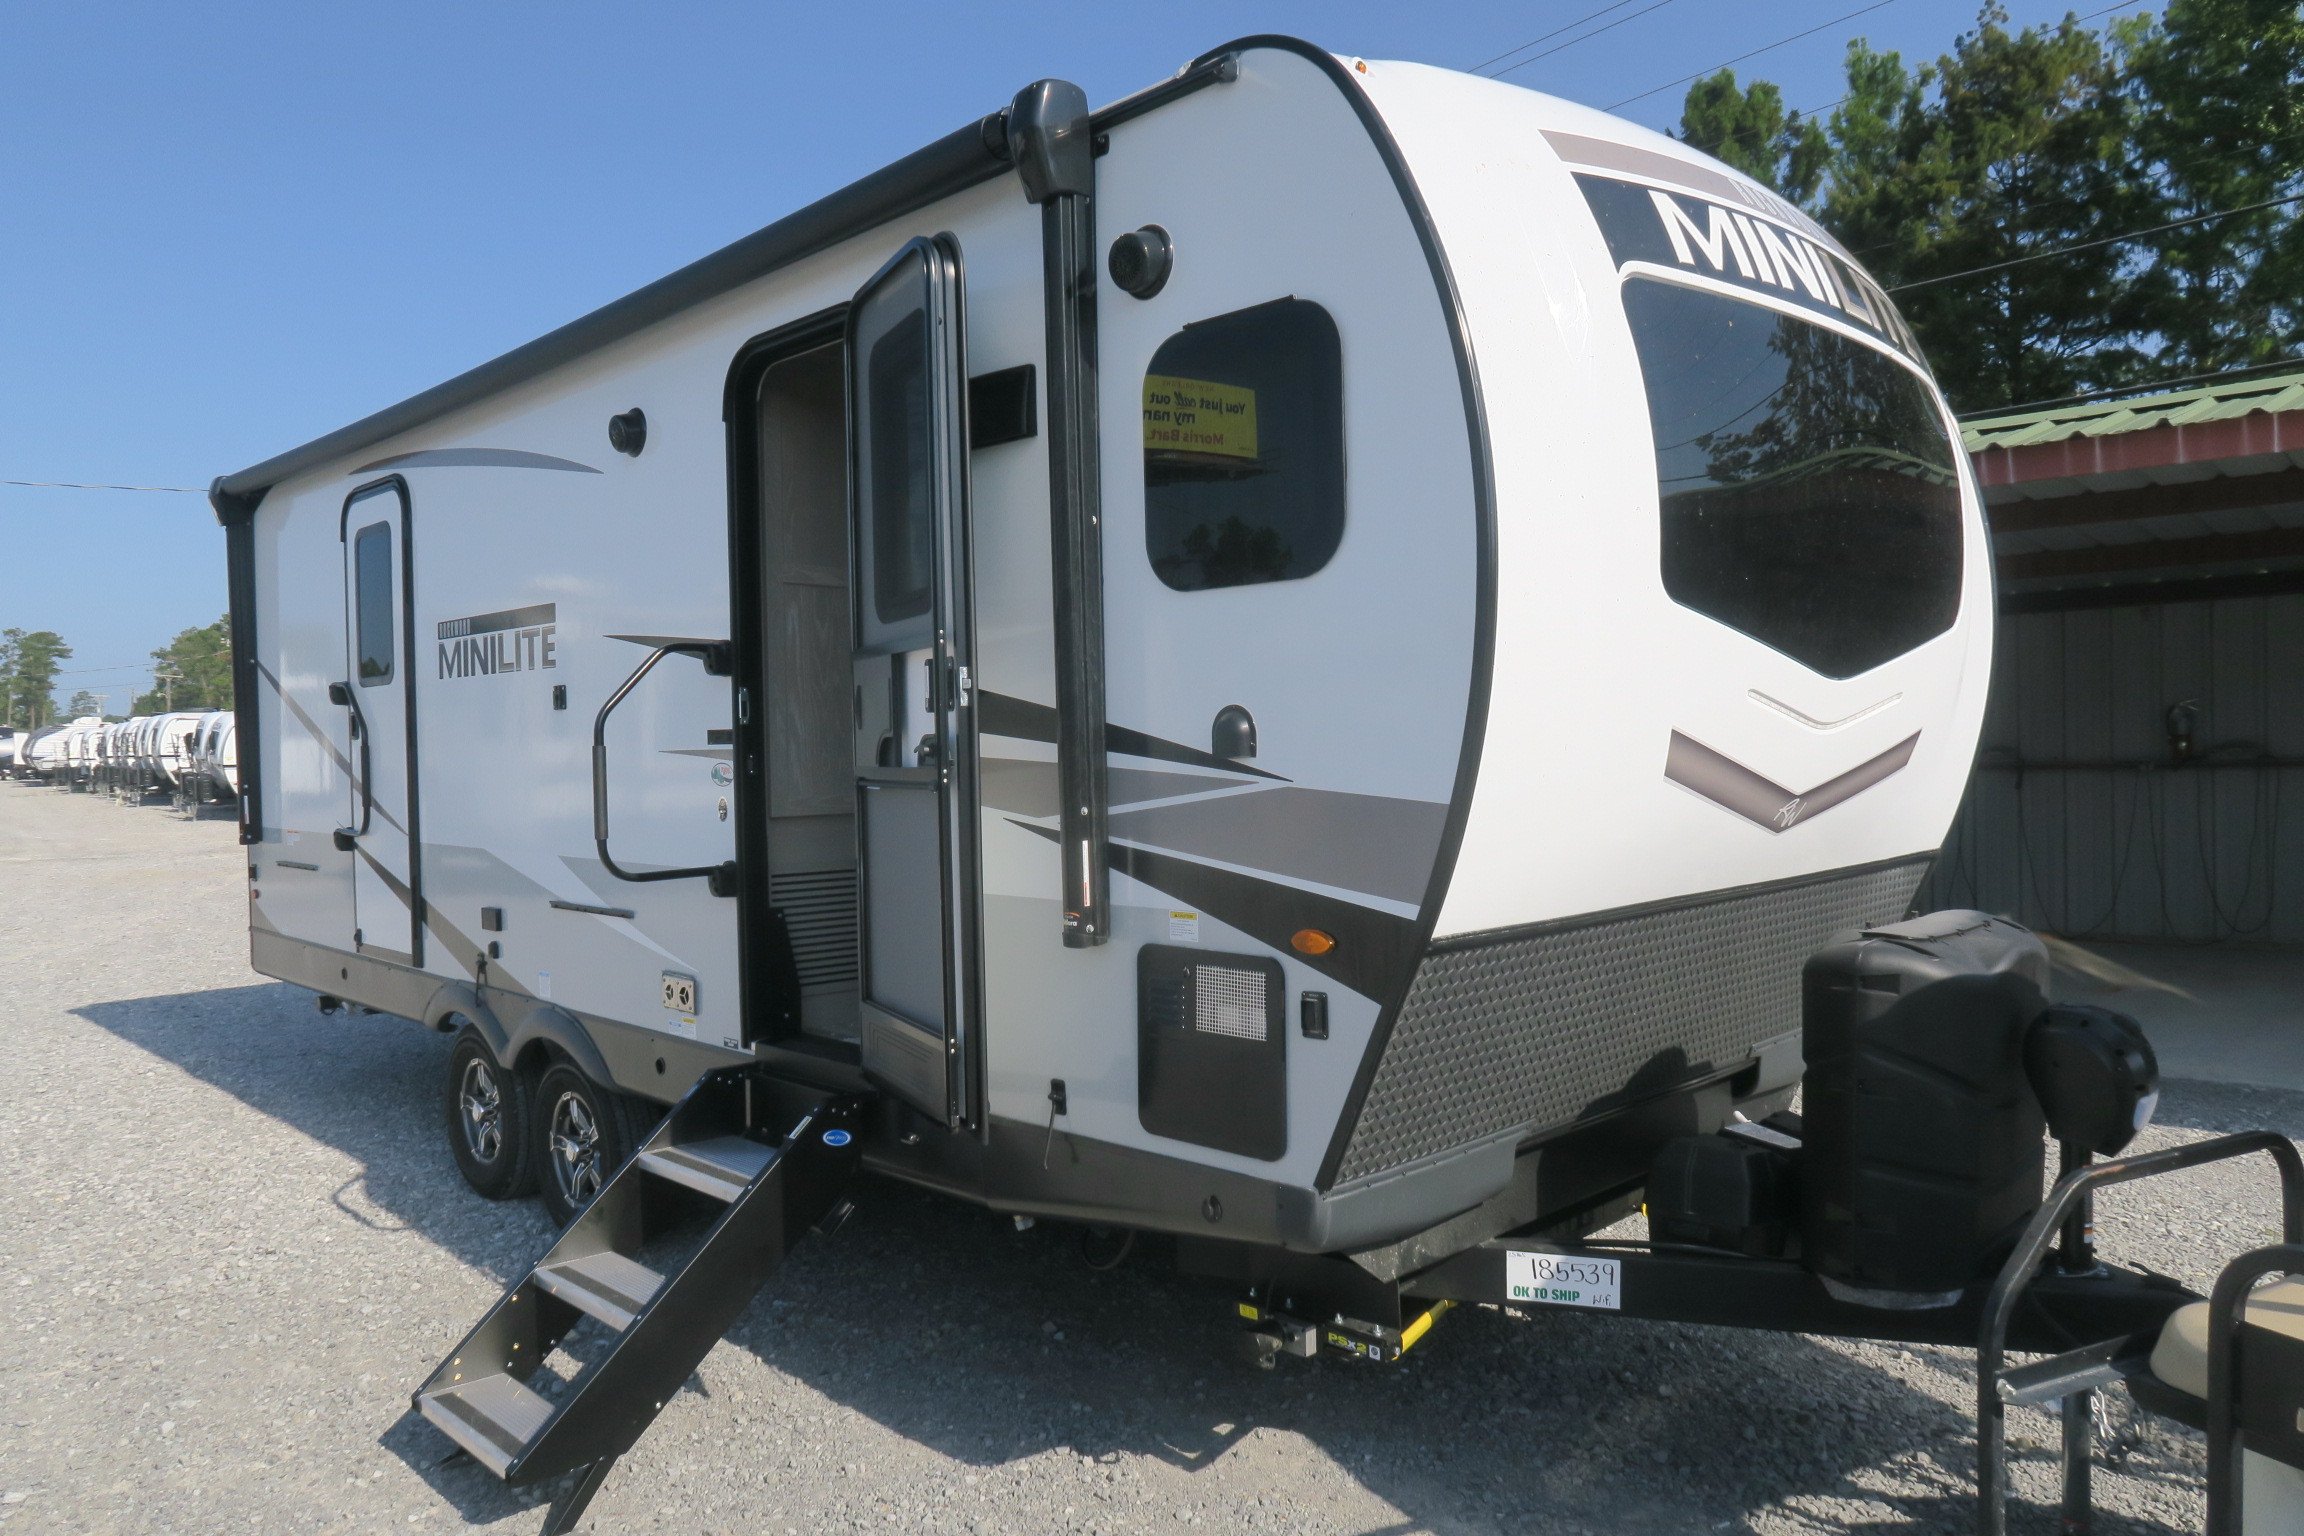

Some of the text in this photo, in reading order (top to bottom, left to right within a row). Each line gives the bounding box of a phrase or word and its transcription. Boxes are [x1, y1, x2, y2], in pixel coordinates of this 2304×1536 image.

[438, 626, 556, 679] MINILITE
[1532, 1258, 1614, 1285] 185539
[1513, 1285, 1580, 1301] OK TO SHIP
